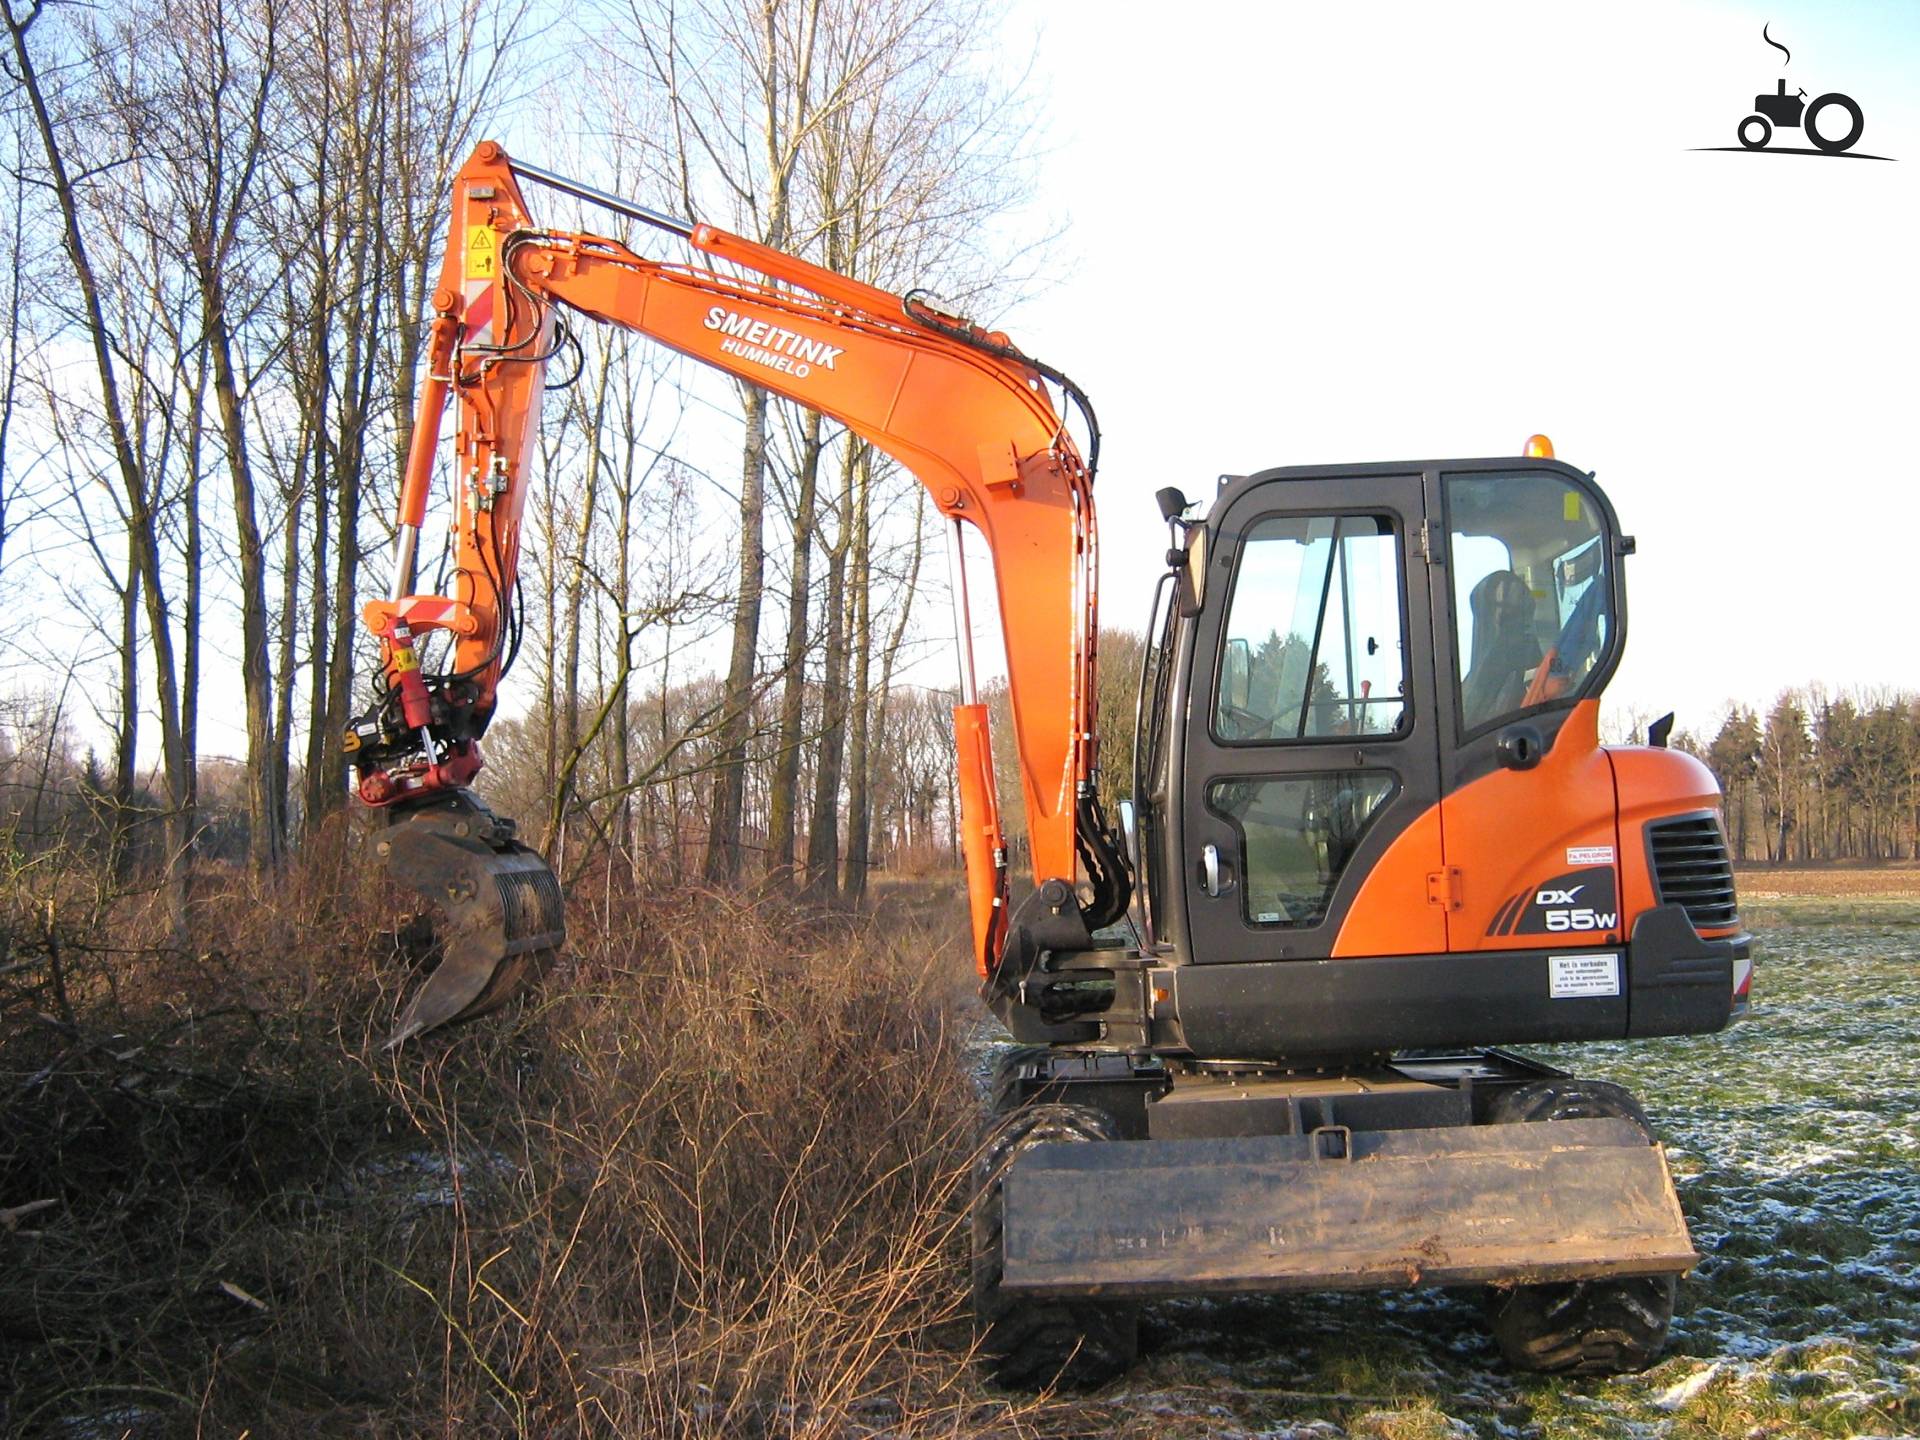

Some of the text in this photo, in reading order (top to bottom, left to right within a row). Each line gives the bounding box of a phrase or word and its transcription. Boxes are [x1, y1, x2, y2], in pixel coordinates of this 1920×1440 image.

[703, 306, 846, 371] SMEITINK
[720, 338, 811, 379] HUMMELO
[1536, 884, 1585, 905] DX
